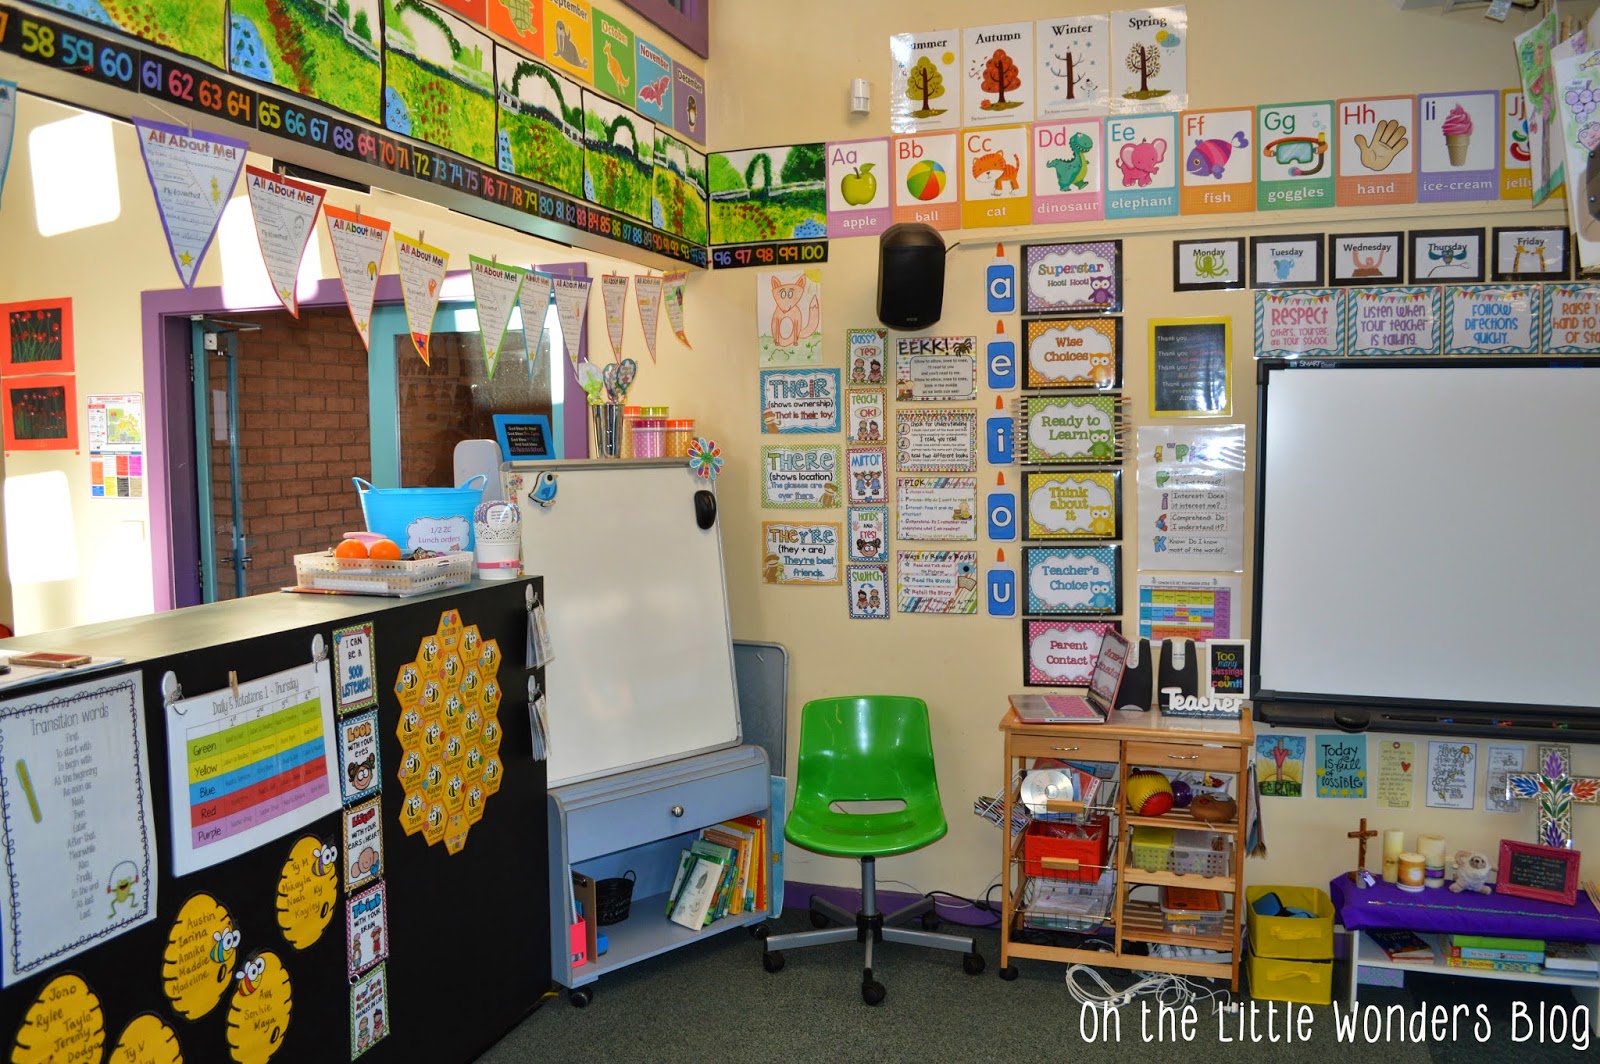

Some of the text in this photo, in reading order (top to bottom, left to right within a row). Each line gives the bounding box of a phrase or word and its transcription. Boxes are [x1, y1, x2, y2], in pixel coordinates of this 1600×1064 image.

[1052, 23, 1093, 36] Winter
[1129, 16, 1167, 30] Spring
[601, 20, 628, 46] October
[975, 31, 1021, 44] Autumn
[908, 38, 948, 50] ummer
[640, 45, 669, 71] November
[677, 70, 702, 92] December
[21, 19, 446, 180] 58 59 60 61 62 63 64 65 66 67 68 72 73
[1344, 103, 1376, 125] Hh
[1187, 118, 1205, 136] Ff
[1265, 112, 1295, 133] Gg
[1039, 127, 1066, 147] Dd
[1112, 124, 1135, 141] Ee
[149, 130, 236, 160] All About Me!
[899, 141, 924, 159] Bb
[968, 136, 991, 152] Cc
[832, 148, 858, 165] Aa
[253, 177, 315, 205] All About Me!
[1357, 182, 1394, 195] hand
[1423, 179, 1492, 191] ice-cream
[1204, 192, 1231, 203] fish
[1268, 187, 1324, 202] goggles
[1038, 201, 1098, 214] dinosaur
[1112, 196, 1172, 210] elephant
[916, 211, 938, 222] ball
[987, 206, 1006, 216] cat
[843, 216, 877, 230] apple
[1343, 243, 1391, 253] Wednesday
[1428, 243, 1467, 253] Thursday
[1517, 238, 1545, 247] Friday
[714, 245, 824, 265] 96 97 98 99 100
[1193, 249, 1225, 259] Monday
[1271, 248, 1303, 257] Tuesday
[1039, 263, 1104, 276] Superstar
[990, 277, 1011, 298] a
[1047, 278, 1089, 287] Hoot! Hoot!
[899, 338, 949, 355] EEKK!
[1056, 337, 1083, 347] Wise
[1044, 352, 1088, 362] Choices
[991, 354, 1011, 375] e
[775, 410, 834, 420] That is their toy.
[860, 409, 876, 417] OK!
[1042, 416, 1100, 429] Ready to
[997, 428, 1004, 452] i
[1049, 429, 1088, 440] Learn
[785, 482, 808, 490] glasses
[1049, 487, 1088, 498] Think
[1050, 498, 1088, 509] about
[1065, 510, 1076, 521] it
[418, 535, 460, 544] Lunch orders
[784, 556, 814, 565] They're
[793, 569, 824, 578] friends.
[1042, 565, 1099, 576] Teacher's
[1050, 579, 1088, 591] Choice
[1050, 640, 1088, 650] Parent
[1047, 655, 1088, 665] Contact
[1211, 667, 1243, 678] blessings
[1211, 679, 1242, 688] count!
[1161, 687, 1242, 712] Teacher
[30, 714, 78, 736] Transition
[193, 742, 217, 757] Green
[1321, 742, 1358, 761] Today
[194, 764, 217, 778] Yellow
[1325, 769, 1333, 777] of
[200, 786, 215, 797] Blue
[201, 807, 217, 819] Red
[198, 827, 222, 842] Purple
[186, 912, 216, 930] Austin
[178, 944, 205, 965] Annika
[178, 957, 210, 977] Maddie
[172, 970, 209, 995] Madeline
[49, 985, 76, 1001] Jono
